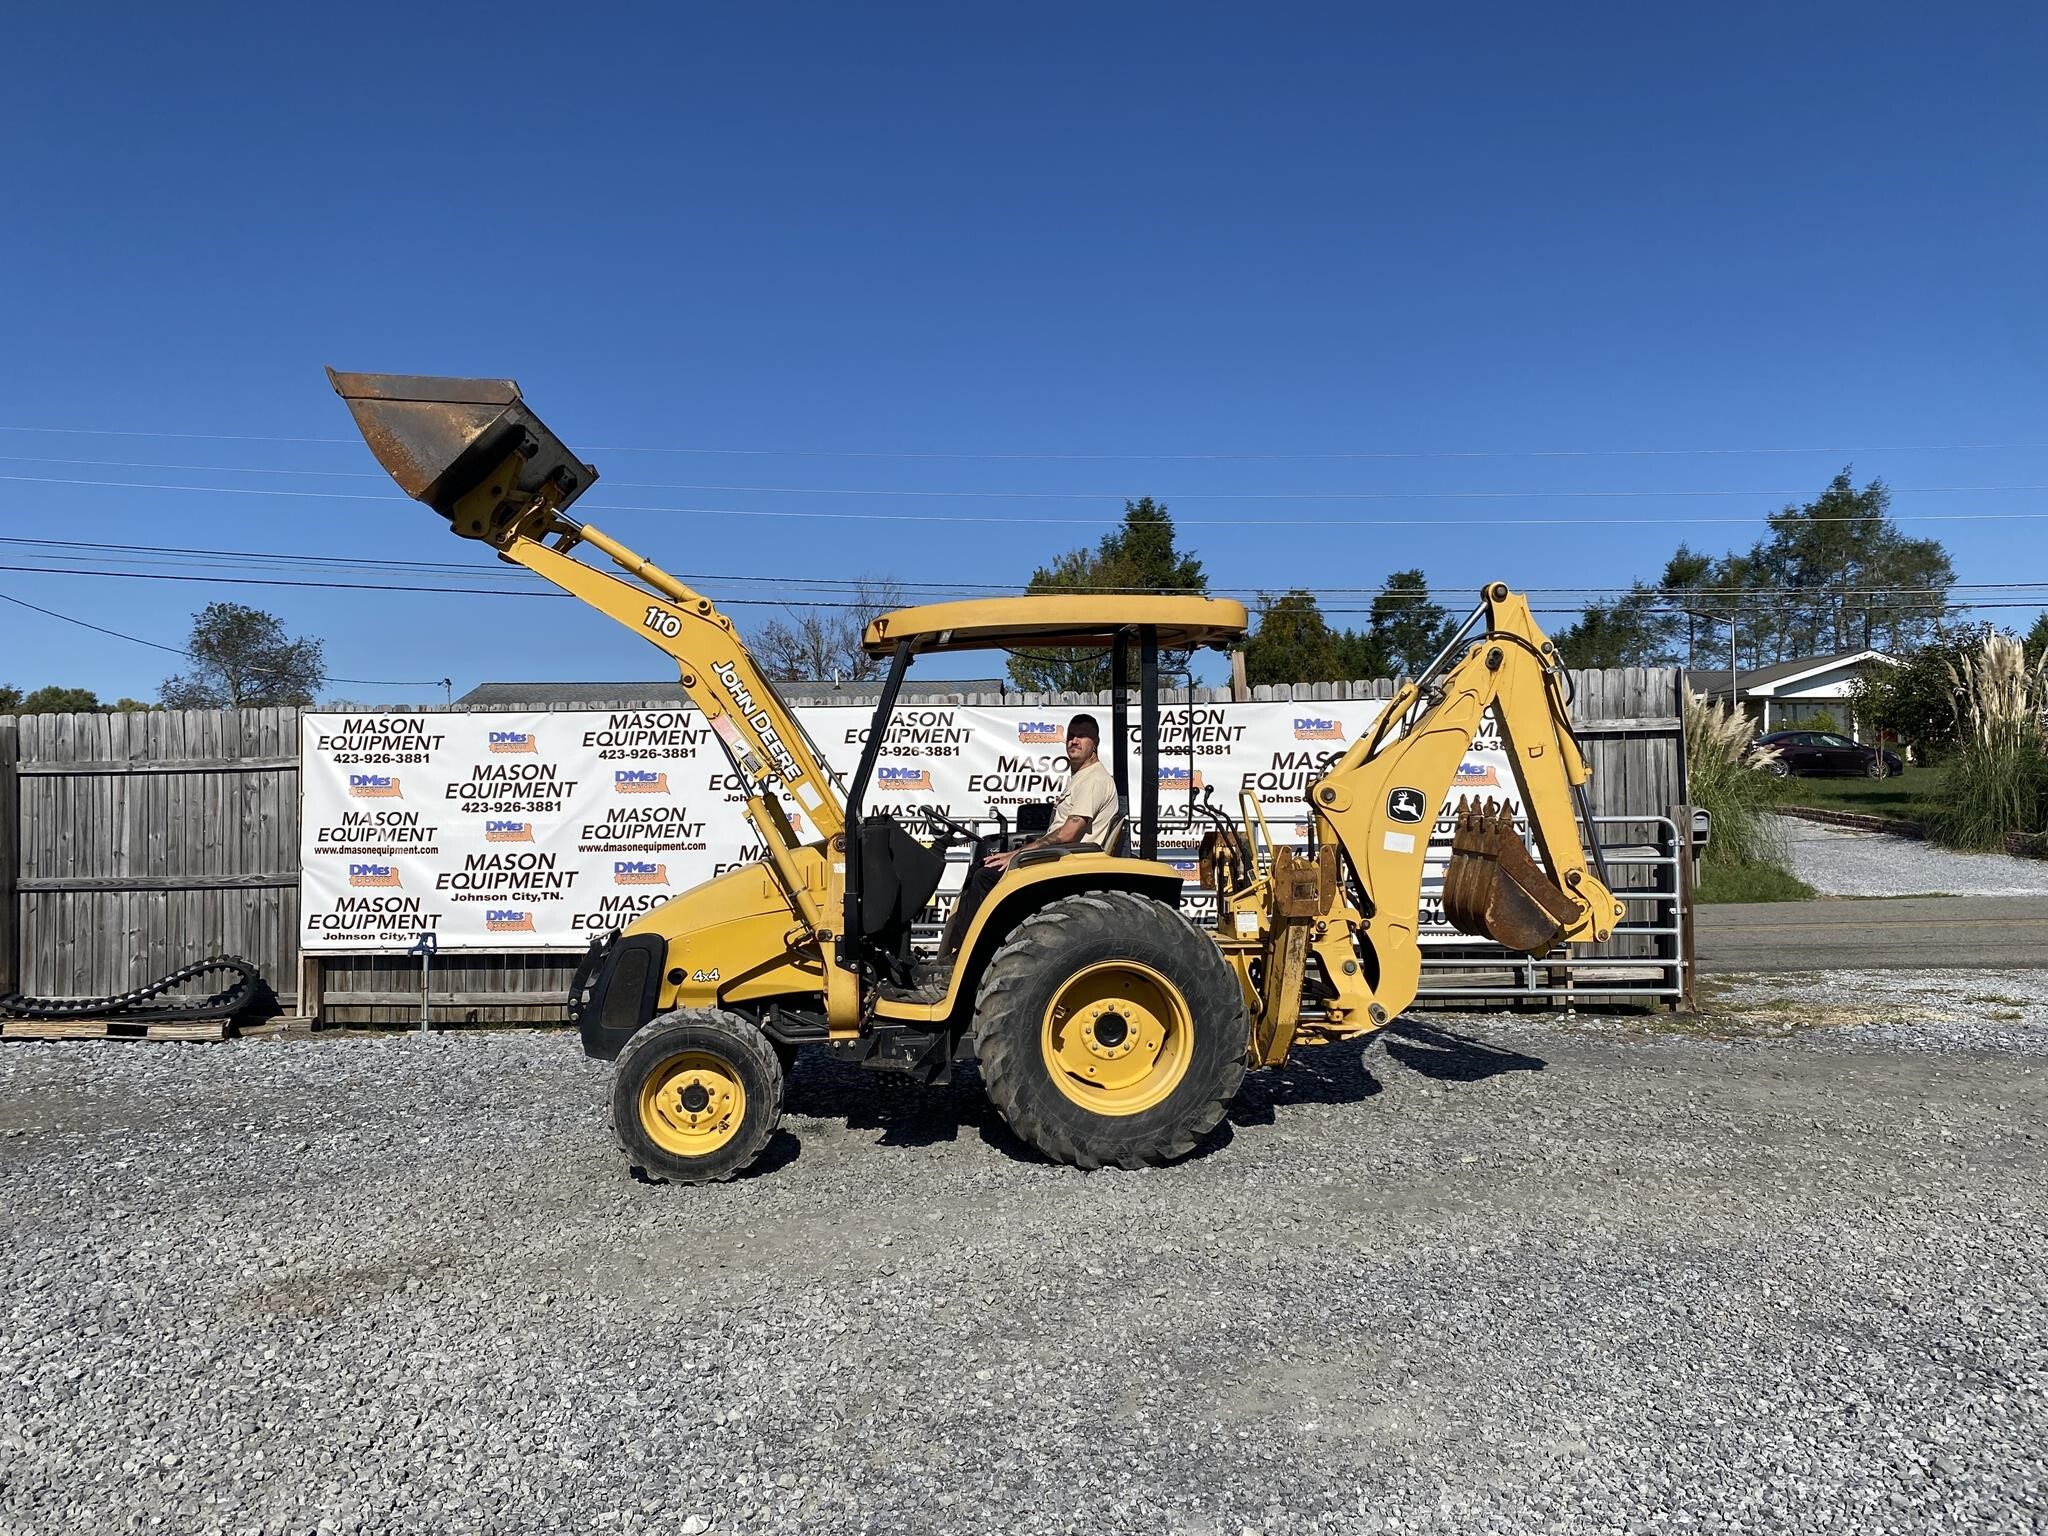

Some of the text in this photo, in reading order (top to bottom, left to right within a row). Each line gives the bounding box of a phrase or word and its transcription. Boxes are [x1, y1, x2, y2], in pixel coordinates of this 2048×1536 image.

[643, 606, 682, 638] 110
[608, 713, 691, 729] MASON
[711, 660, 757, 717] JOHN
[749, 710, 804, 783] DEERE
[889, 711, 954, 727] ASON
[1158, 709, 1225, 726] ASON
[342, 718, 425, 734] MASON
[317, 735, 445, 751] EQUIPMENT
[583, 730, 711, 747] EQUIPMENT
[333, 754, 430, 764] 423-926-3881
[599, 749, 696, 759] 423-926-3881
[880, 746, 960, 756] 3-926-3881
[472, 763, 557, 781] MASON
[997, 755, 1071, 773] MASO
[445, 781, 578, 800] EQUIPMENT
[968, 775, 1072, 792] EQUIPM
[461, 802, 562, 813] 423-926-3881
[984, 796, 1041, 805] Johnson
[341, 811, 419, 826] MASON
[606, 807, 686, 823] MASON
[317, 827, 438, 842] EQUIPMENT
[581, 823, 705, 839] EQUIPMENT
[314, 845, 439, 856] www.dmasonequipment.com
[579, 841, 706, 853] www.dmasonequipment.com
[464, 853, 557, 871] MASON
[435, 871, 579, 891] EQUIPMENT
[451, 891, 564, 902] Johnson City,TN.
[599, 895, 677, 911] MASO
[335, 897, 420, 913] MASON
[307, 914, 442, 930] EQUIPMENT
[322, 932, 375, 940] Johnson
[692, 968, 720, 982] 4x4
